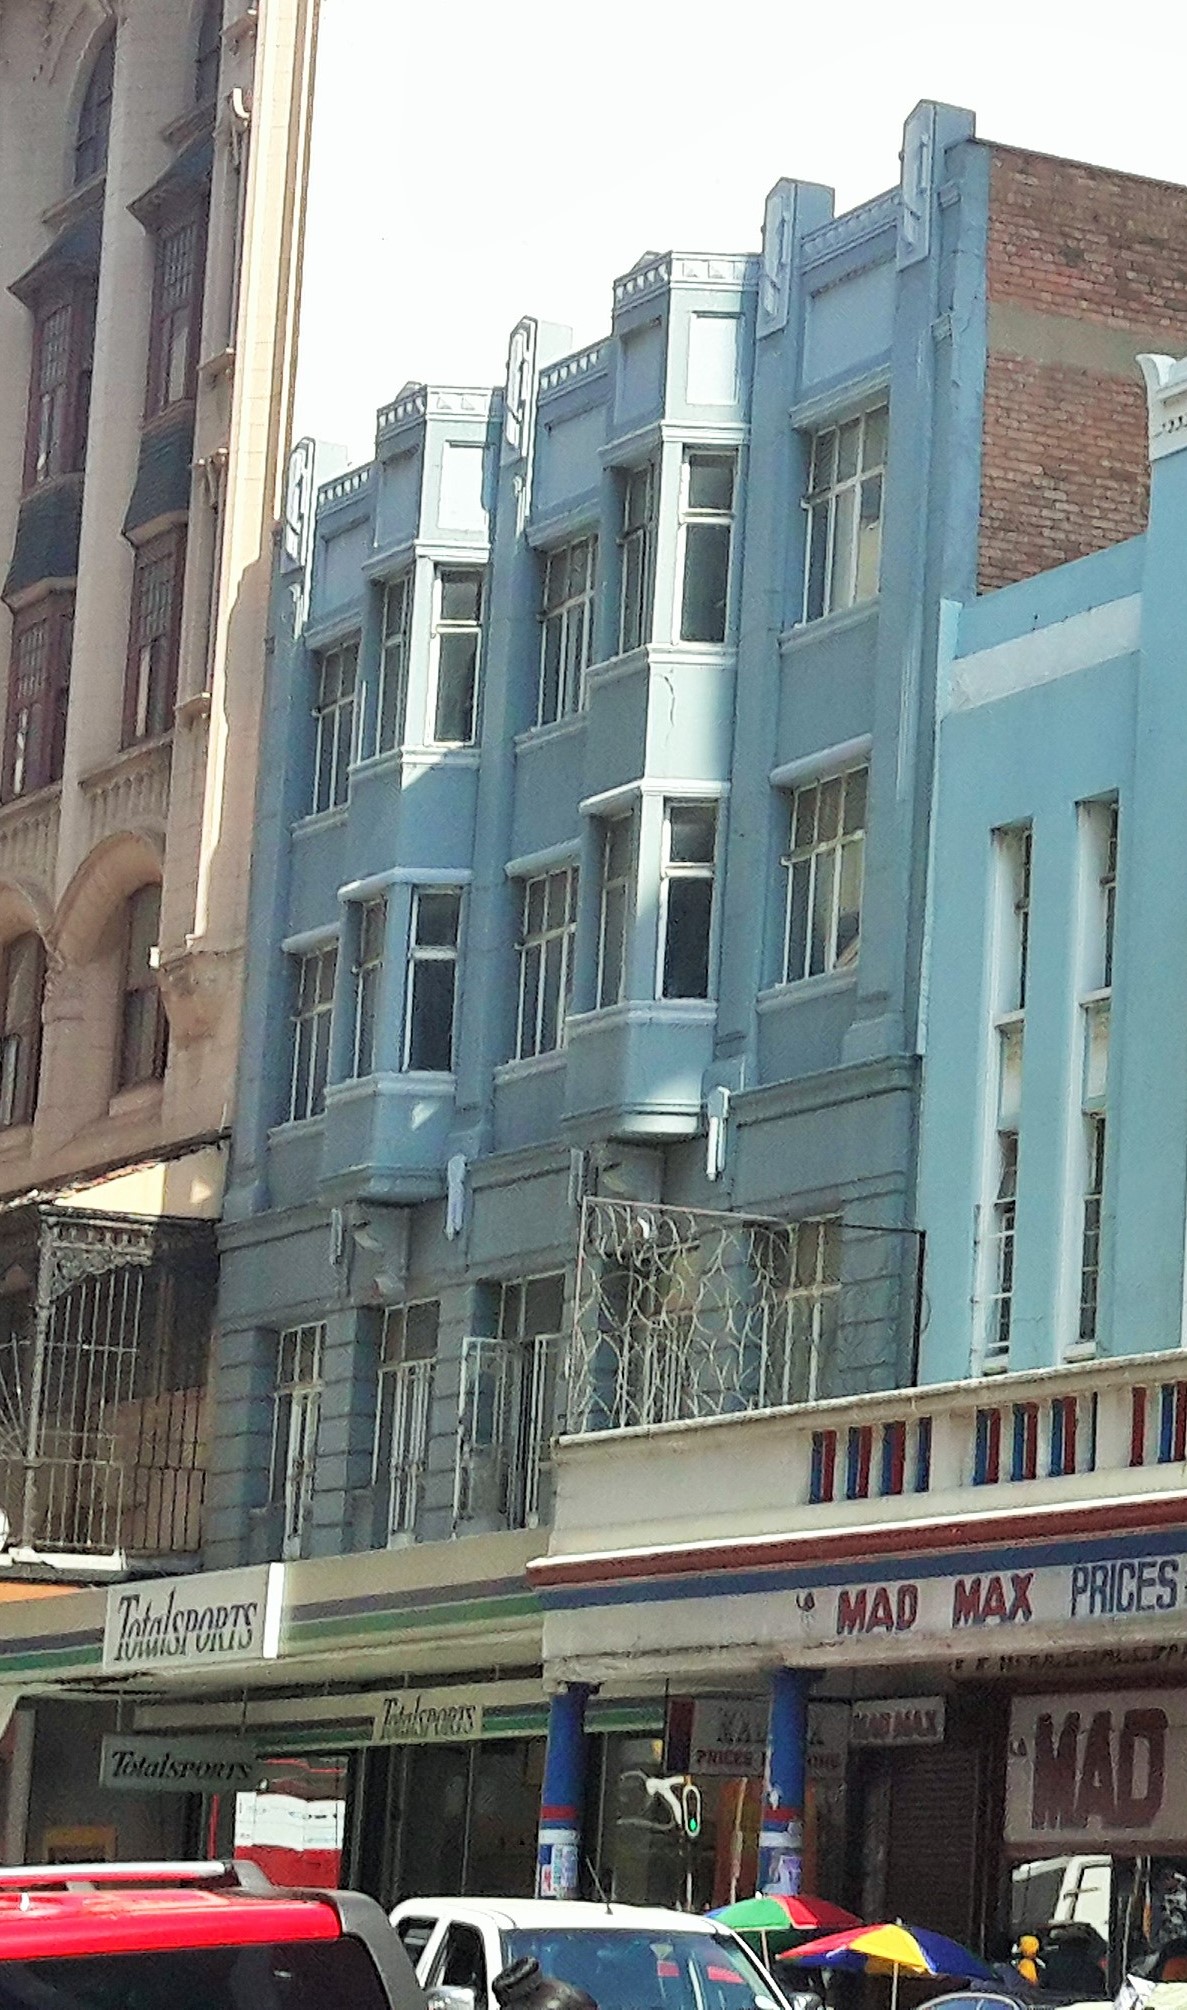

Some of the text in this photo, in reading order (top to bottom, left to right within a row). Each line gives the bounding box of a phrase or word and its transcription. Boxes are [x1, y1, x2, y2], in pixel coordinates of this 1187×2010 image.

[835, 1559, 1179, 1634] MAD MAX PRICES
[1031, 1708, 1168, 1830] MAD
